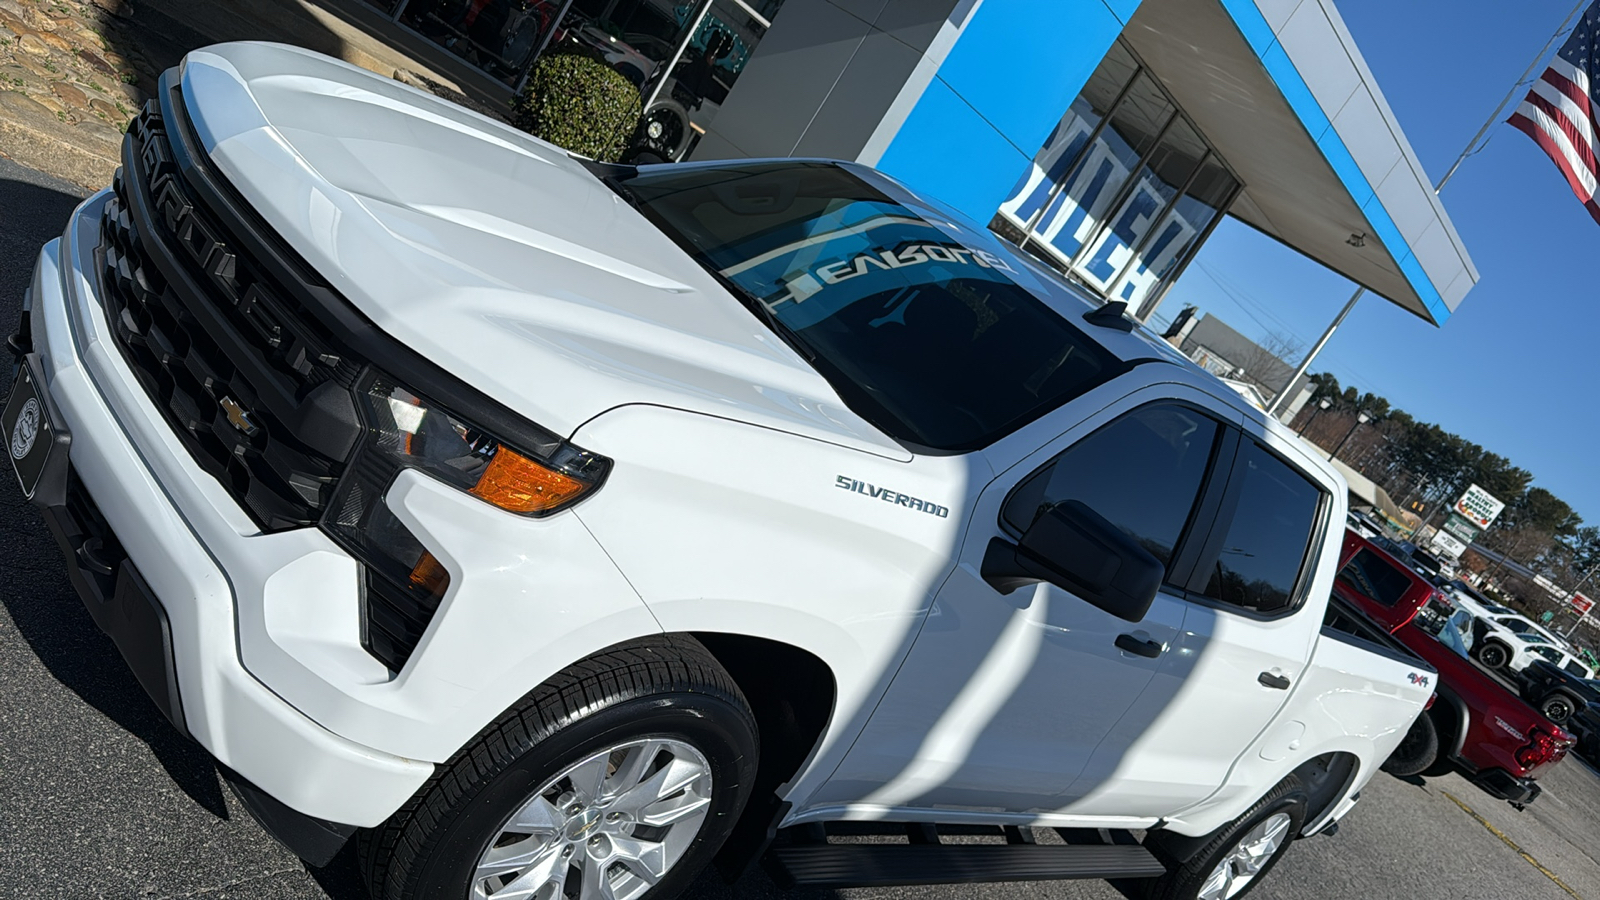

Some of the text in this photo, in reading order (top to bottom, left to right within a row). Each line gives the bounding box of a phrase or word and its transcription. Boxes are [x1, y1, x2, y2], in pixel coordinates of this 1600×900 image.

[834, 474, 949, 519] SILVERADO
[1466, 496, 1494, 516] HARVEST
[1467, 490, 1494, 508] HEALTHY
